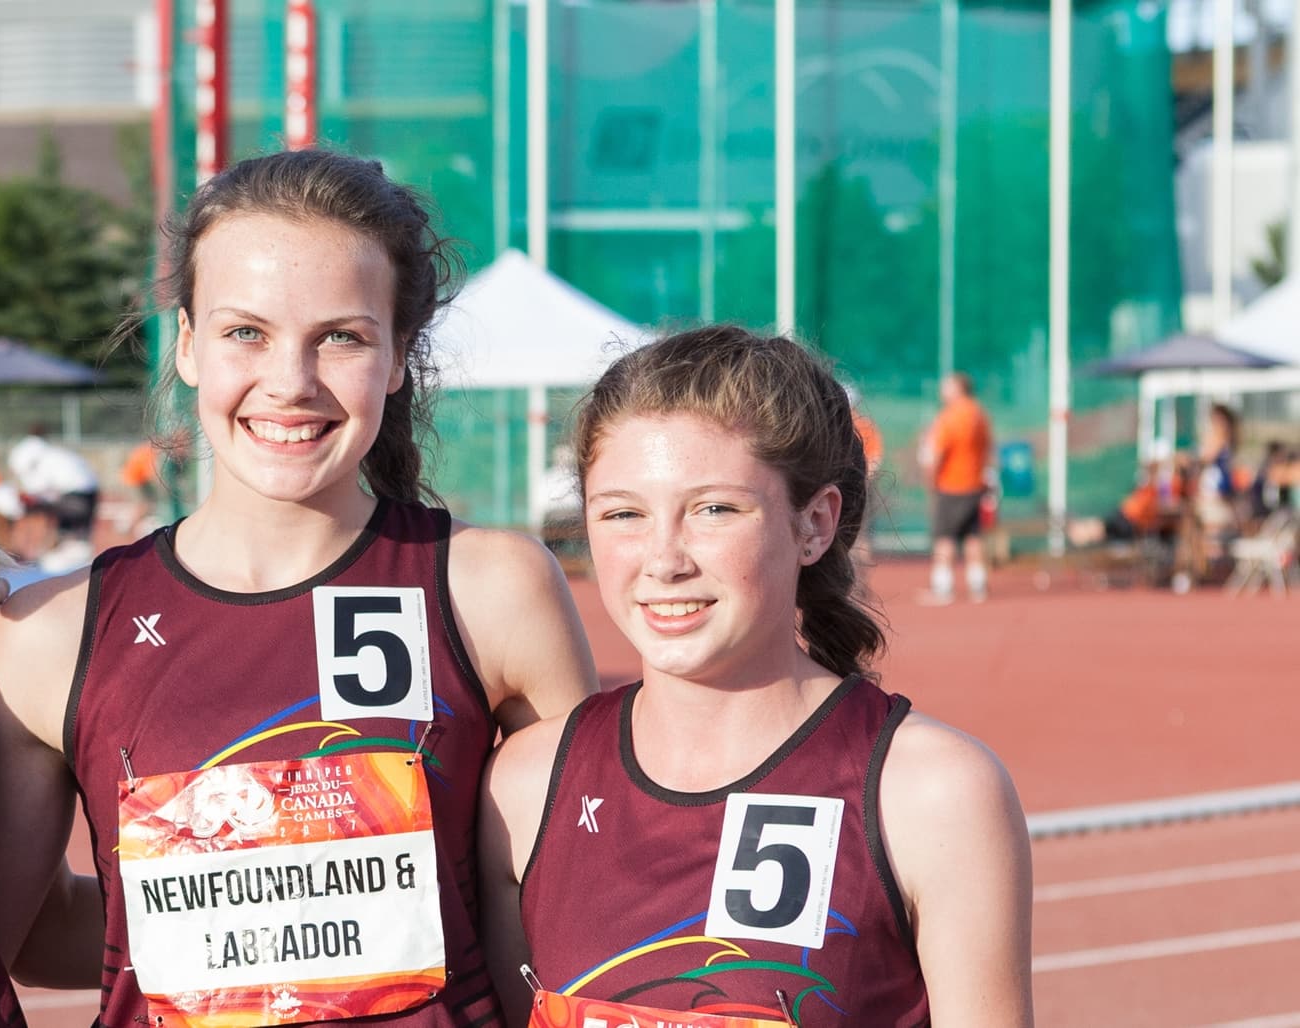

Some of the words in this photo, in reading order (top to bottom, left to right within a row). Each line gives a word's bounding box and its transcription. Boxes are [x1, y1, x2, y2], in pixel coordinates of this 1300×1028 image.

[333, 597, 412, 706] 5
[275, 764, 352, 784] WINNIPEG
[289, 782, 319, 797] JEUX
[322, 780, 340, 791] DU
[281, 791, 356, 811] CANADA
[293, 808, 342, 822] GAMES
[141, 856, 386, 914] NEWFOUNDLAND
[395, 852, 416, 890] &
[725, 804, 816, 929] 5
[204, 920, 362, 970] LABRADOR
